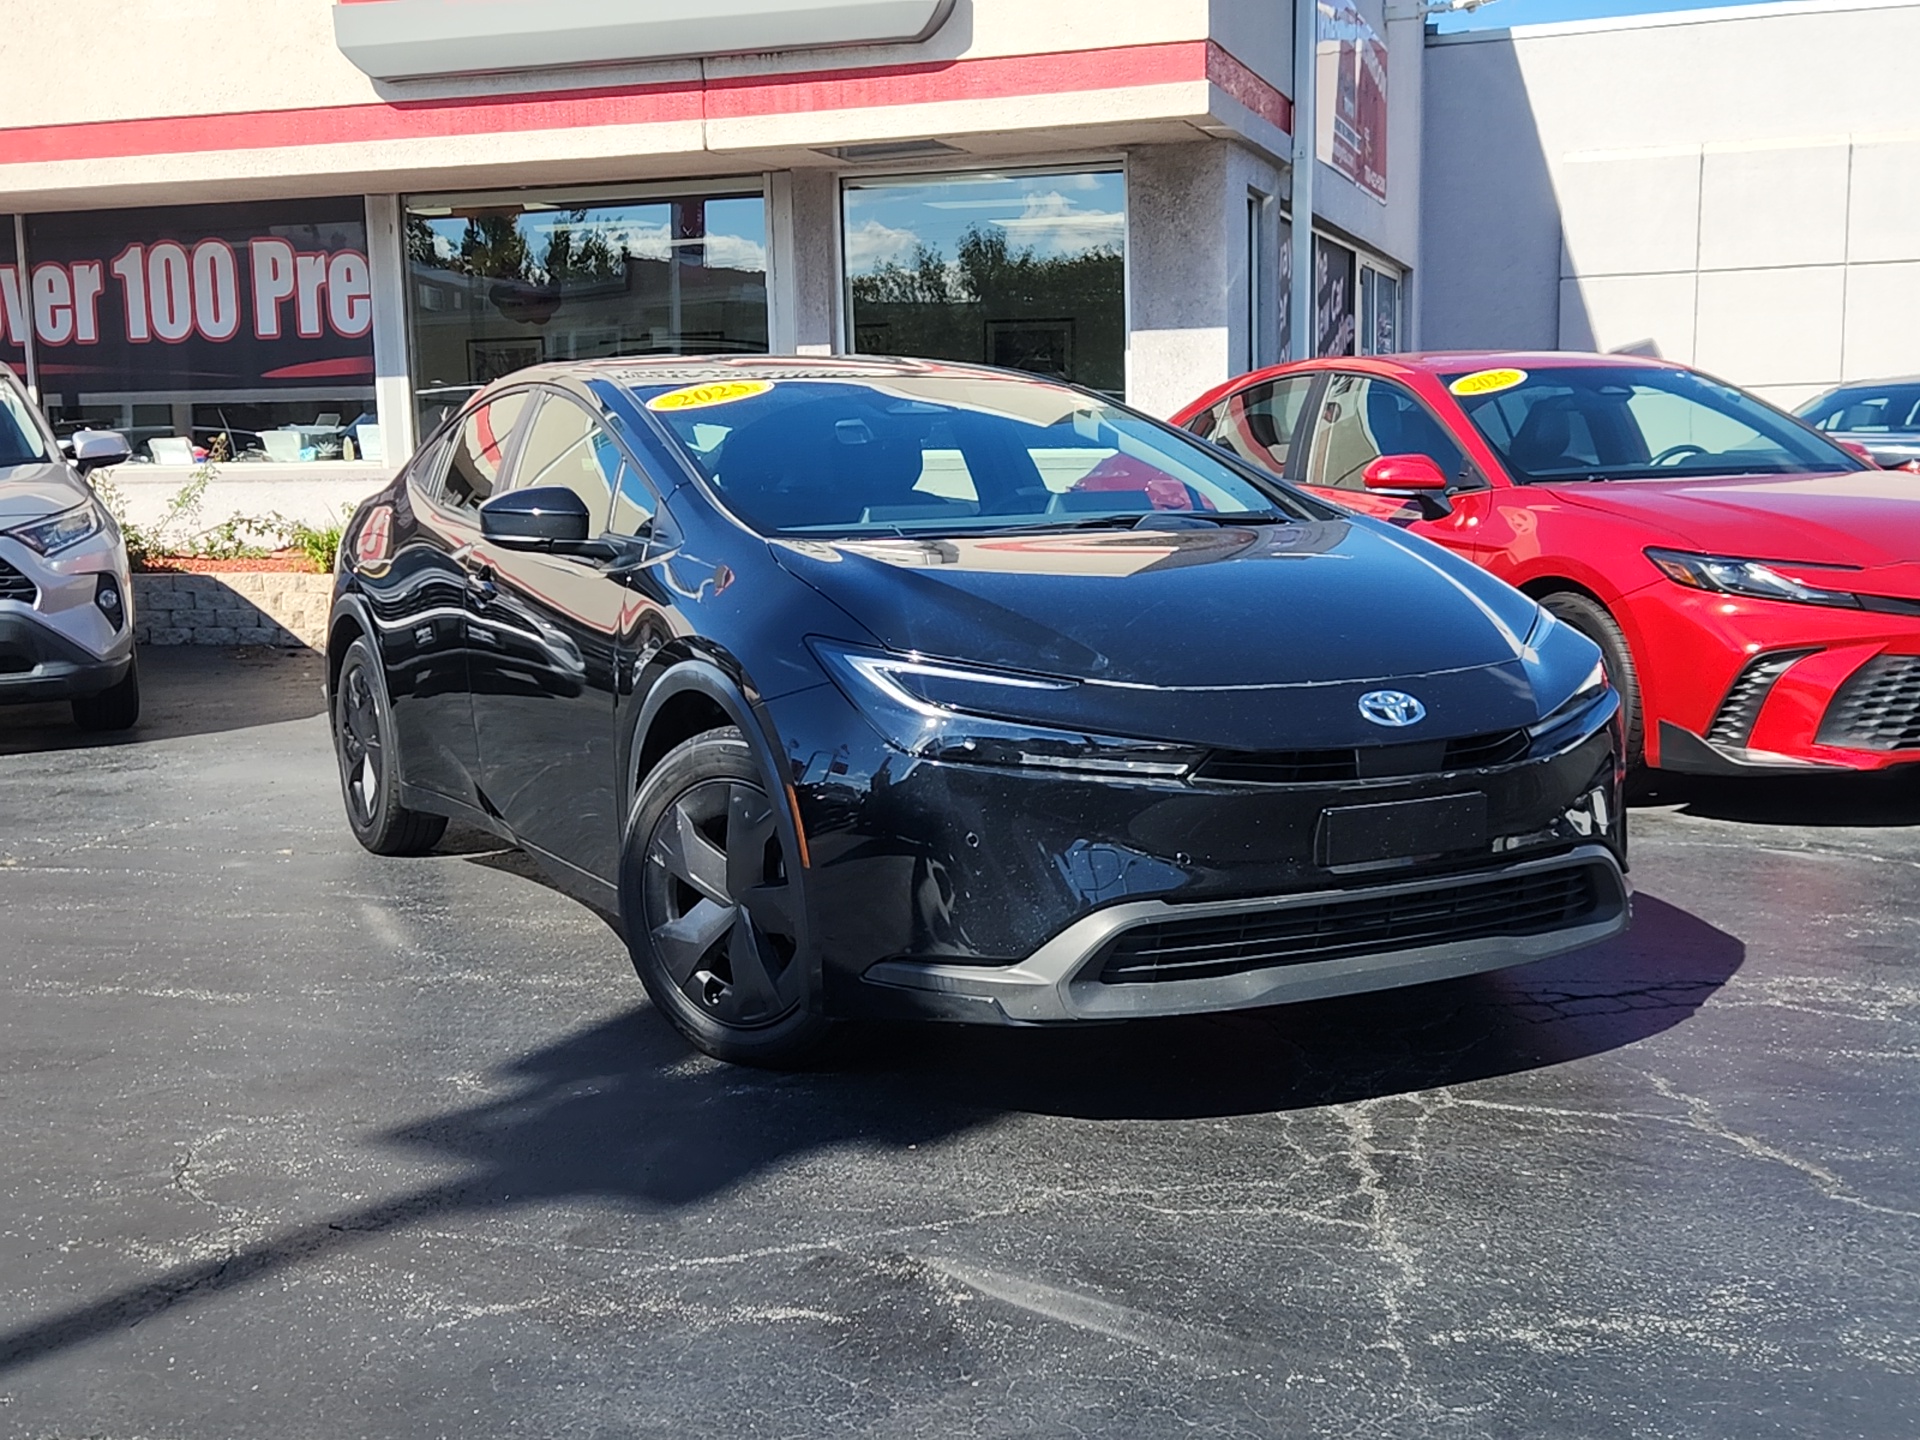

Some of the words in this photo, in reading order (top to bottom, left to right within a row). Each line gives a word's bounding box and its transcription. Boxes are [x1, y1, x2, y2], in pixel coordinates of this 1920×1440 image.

[0, 260, 104, 347] ver
[110, 237, 240, 343] 100
[248, 236, 373, 340] Pre
[1471, 371, 1512, 392] 2025
[675, 383, 750, 407] 2025
